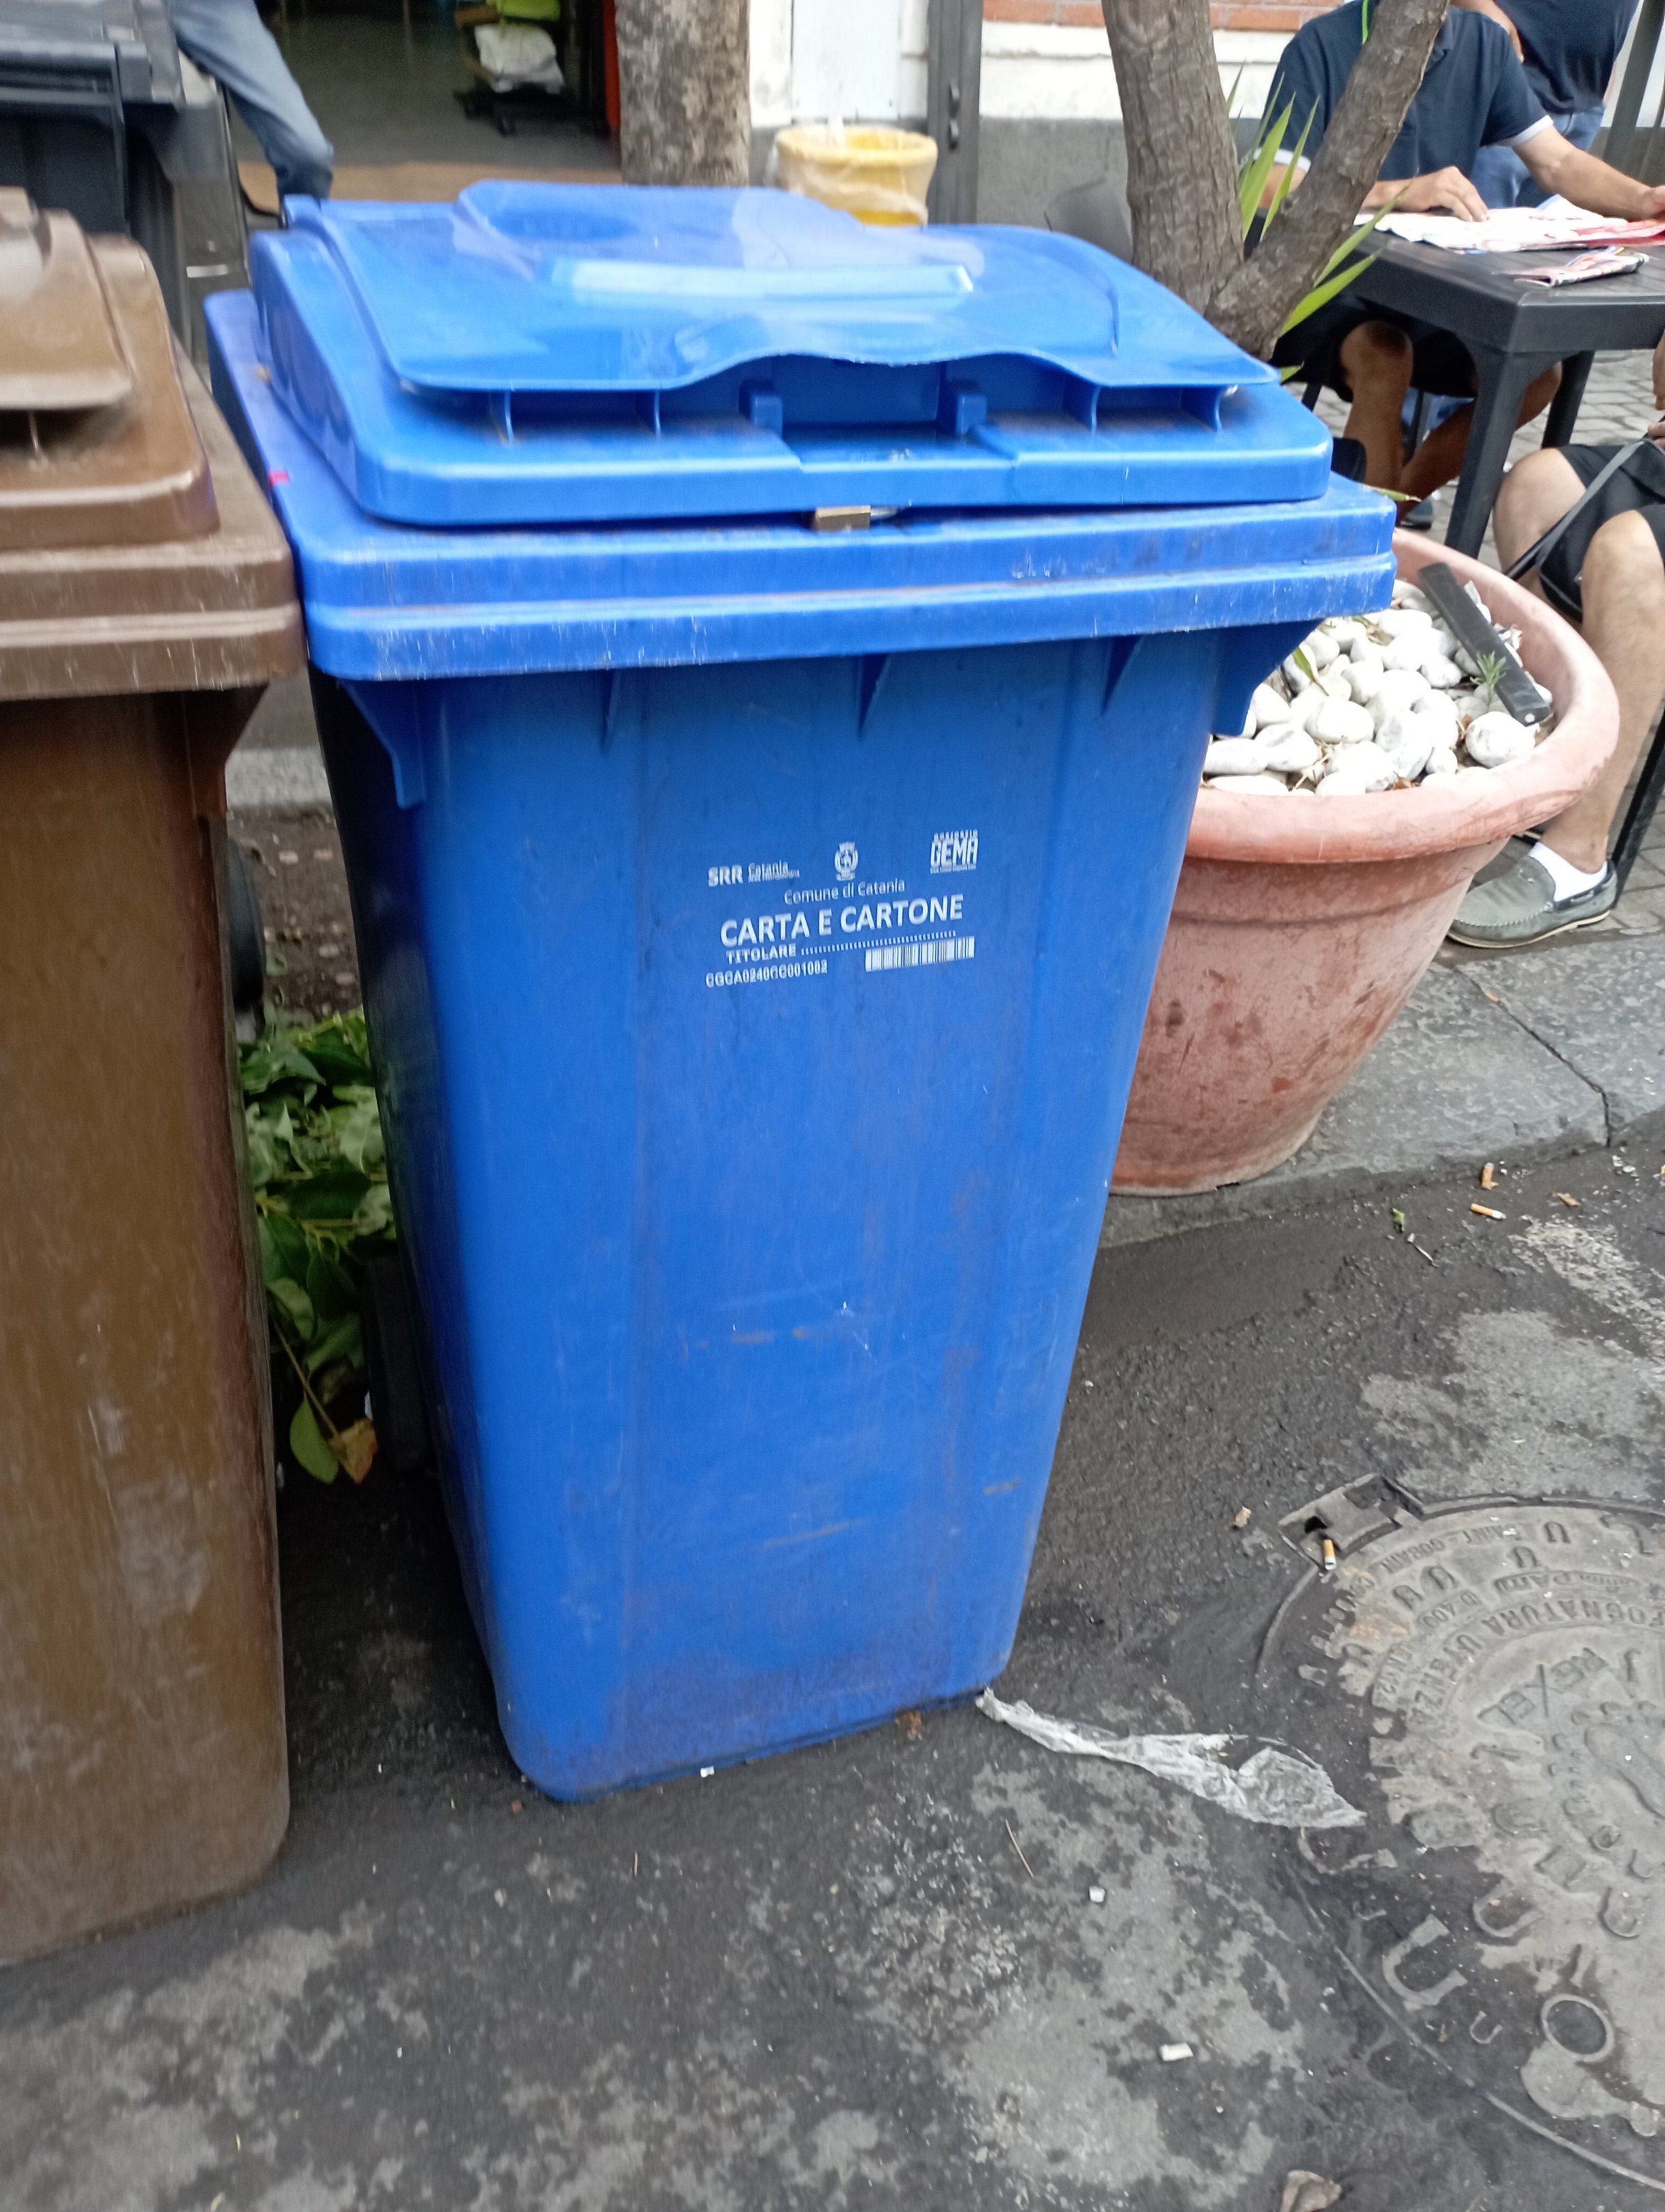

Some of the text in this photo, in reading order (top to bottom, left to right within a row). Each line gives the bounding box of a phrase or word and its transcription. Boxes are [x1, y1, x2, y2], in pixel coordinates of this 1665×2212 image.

[930, 837, 978, 866] GEMA
[708, 865, 743, 887] SRR
[784, 878, 905, 905] Comune di Catania
[720, 894, 964, 947] CARTA E CARTONE
[726, 943, 796, 964] TITOLARE
[1480, 1600, 1665, 1637] FOGNATURA
